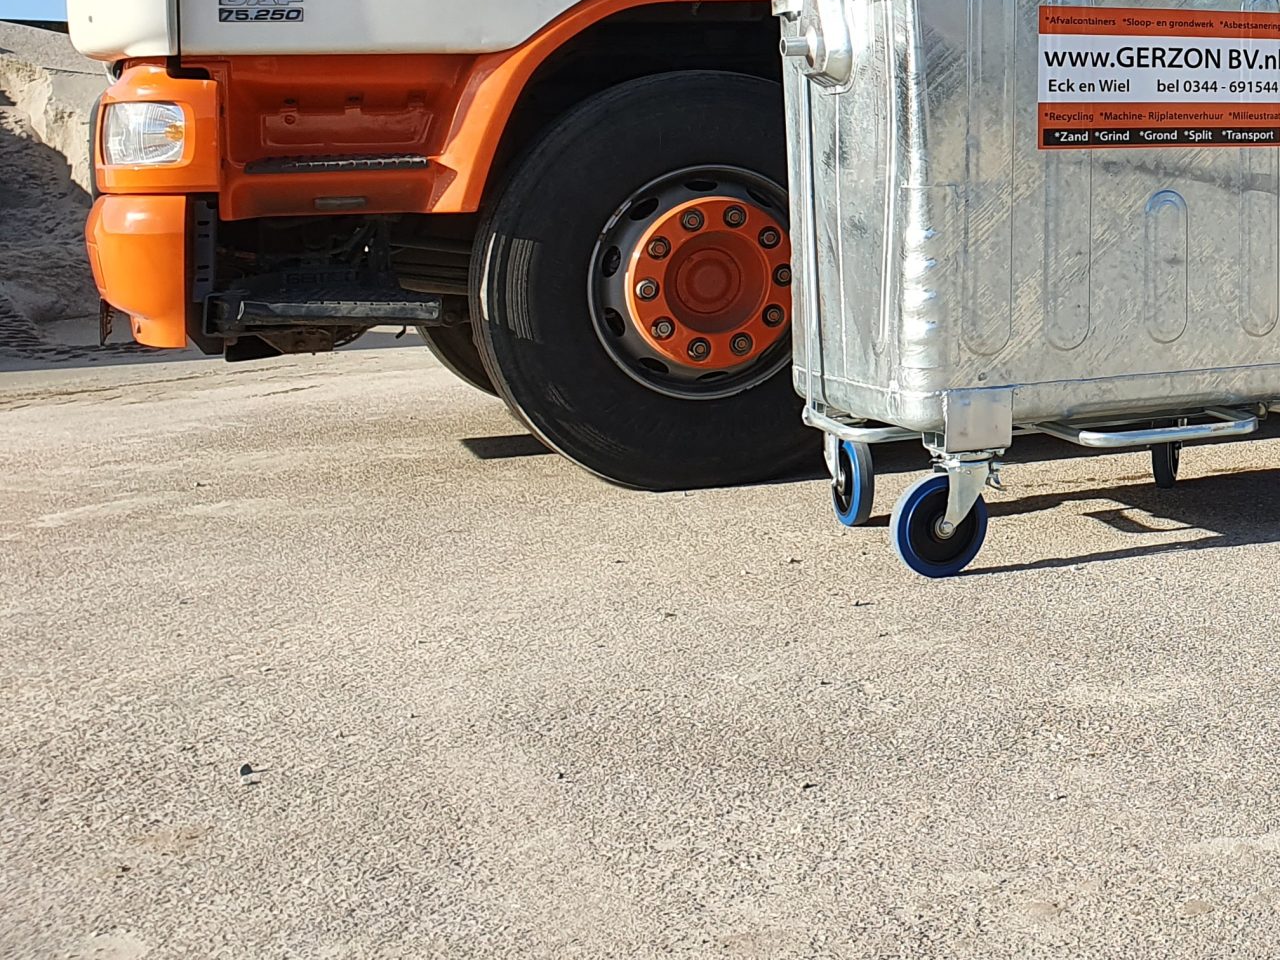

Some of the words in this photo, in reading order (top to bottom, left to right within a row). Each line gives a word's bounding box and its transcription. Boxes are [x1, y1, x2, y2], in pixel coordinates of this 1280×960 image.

[219, 8, 303, 21] 75.250
[1169, 20, 1214, 28] grondwerk
[1044, 47, 1221, 69] www.GERZON
[1049, 79, 1075, 92] Eck
[1079, 82, 1095, 92] en
[1099, 79, 1130, 92] Wiel
[1157, 79, 1179, 92] bel
[1183, 80, 1218, 93] 0344
[1229, 81, 1279, 93] 691544
[1148, 111, 1223, 122] Rijplatenverhuur
